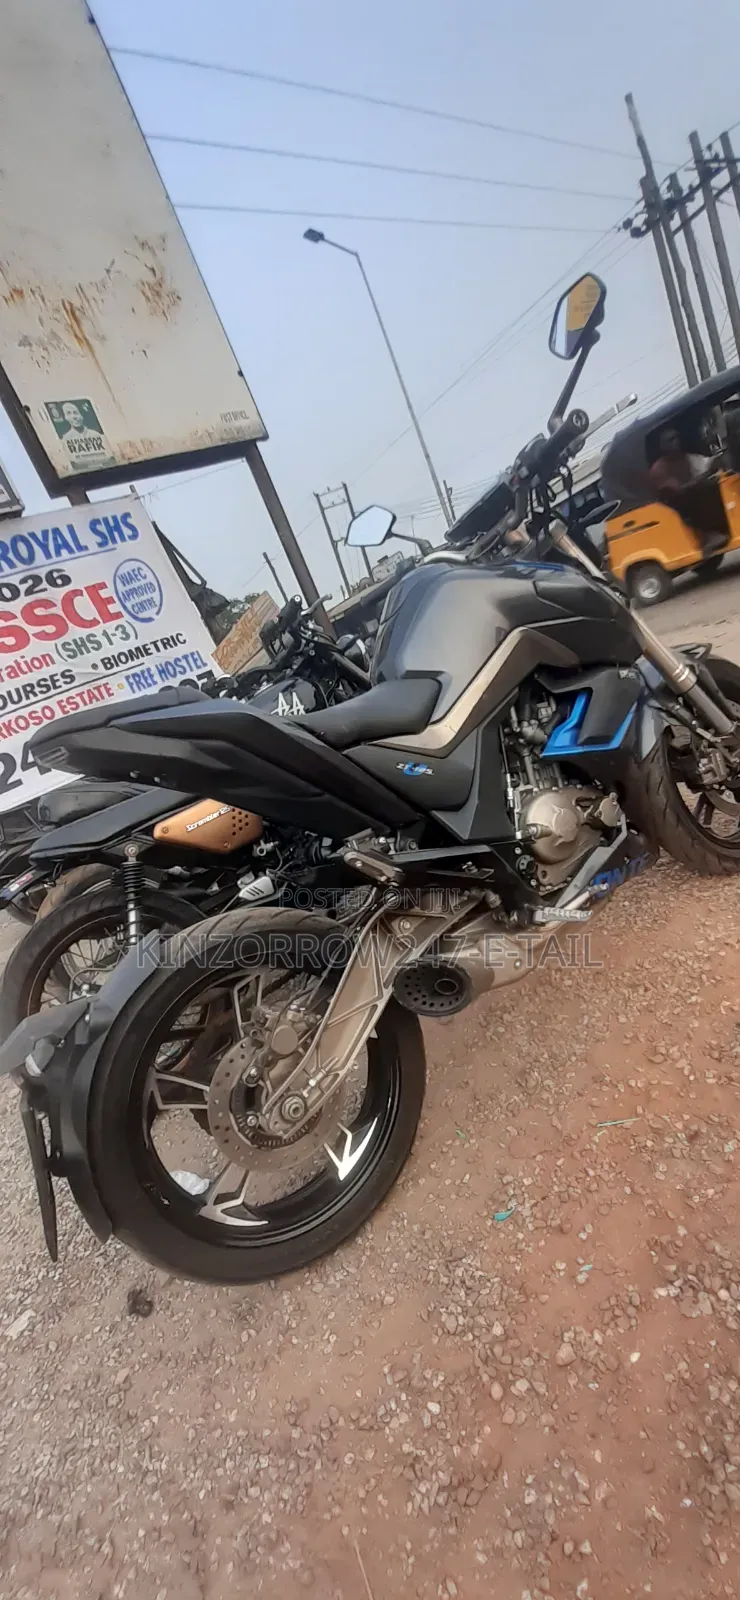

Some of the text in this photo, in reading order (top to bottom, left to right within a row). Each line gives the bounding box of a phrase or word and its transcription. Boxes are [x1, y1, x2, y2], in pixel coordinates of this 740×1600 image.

[68, 441, 106, 454] RAFIK
[88, 512, 140, 549] SHS
[117, 566, 148, 587] WAEC
[120, 581, 157, 604] APPROVED
[130, 596, 158, 615] CENTRE
[54, 632, 103, 663] (SHS
[100, 632, 188, 672] BIOMETRIC
[56, 681, 115, 716] ESTATE
[124, 667, 160, 695] FREE
[154, 649, 209, 683] HOSTEL
